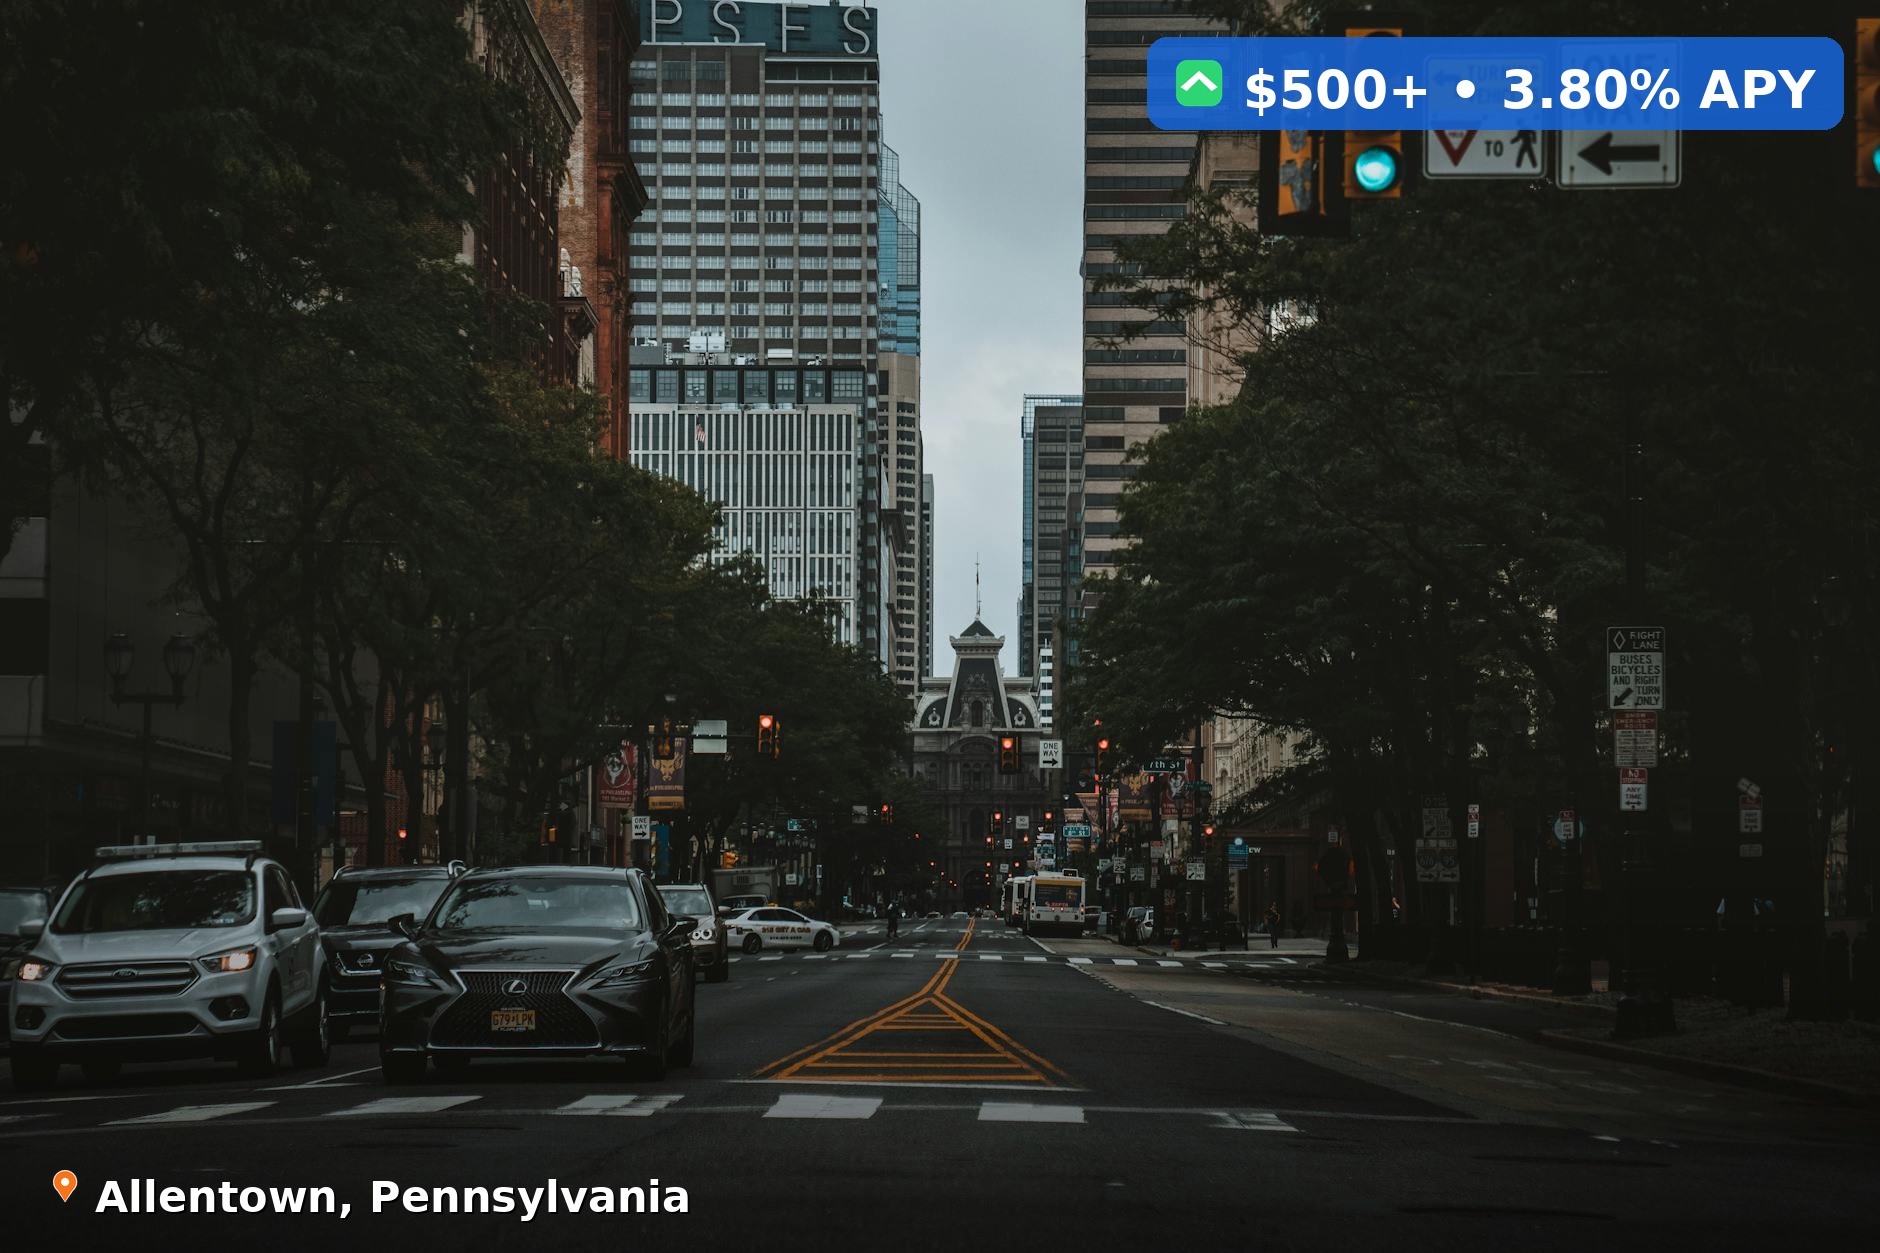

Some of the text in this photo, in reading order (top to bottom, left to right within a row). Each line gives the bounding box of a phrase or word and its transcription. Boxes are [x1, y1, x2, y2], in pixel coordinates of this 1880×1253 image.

[651, 0, 870, 54] PSFS
[1485, 141, 1504, 157] TO
[1632, 640, 1661, 650] LANE
[1619, 654, 1652, 665] BUSES
[1611, 665, 1661, 675] BICYCLES
[1613, 675, 1659, 685] AND RIGHT
[1636, 685, 1661, 695] TURN
[1636, 696, 1661, 706] ONLY
[1043, 742, 1058, 750] ONE
[1043, 750, 1059, 758] WAY
[1149, 761, 1165, 769] 7th
[1628, 769, 1640, 778] NO
